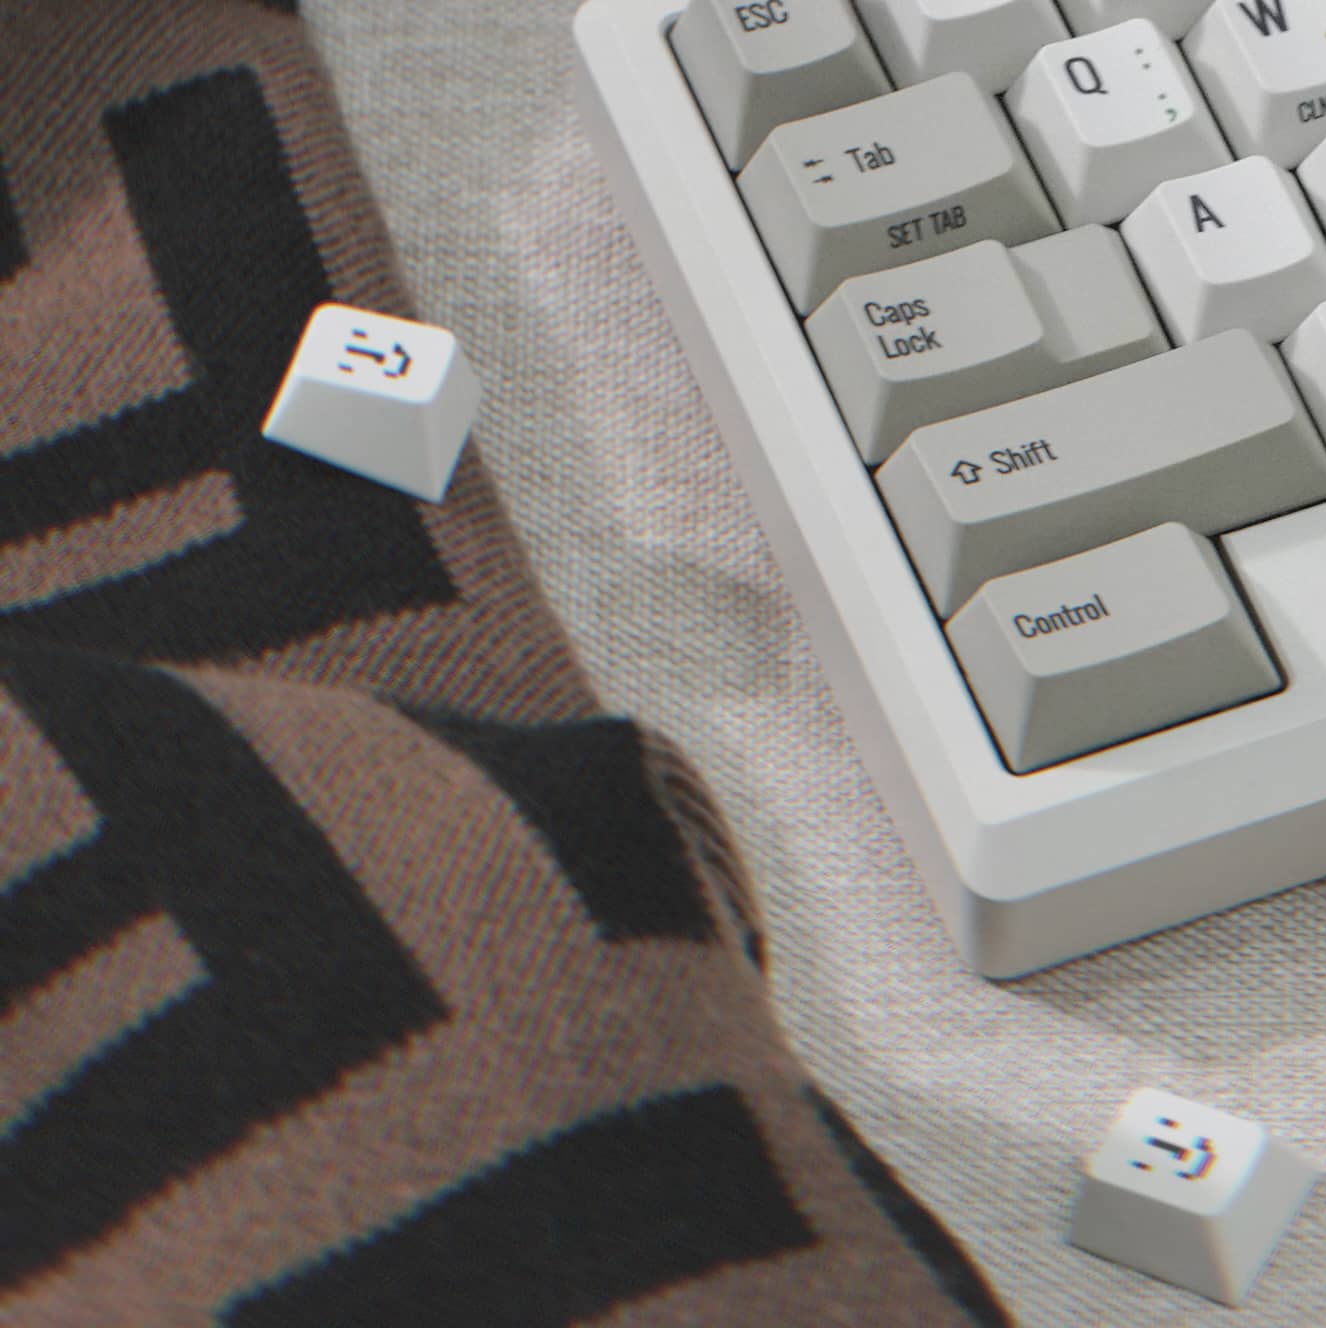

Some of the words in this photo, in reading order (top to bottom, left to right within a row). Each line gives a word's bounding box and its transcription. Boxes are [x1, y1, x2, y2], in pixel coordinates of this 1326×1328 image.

[1063, 56, 1109, 95] Q
[843, 140, 897, 176] Tab
[887, 218, 924, 250] SET
[928, 204, 969, 236] TAB
[1188, 192, 1227, 234] A
[863, 296, 931, 330] Caps
[875, 325, 944, 361] Lock
[988, 438, 1059, 476] Shift
[1013, 593, 1111, 640] Control
